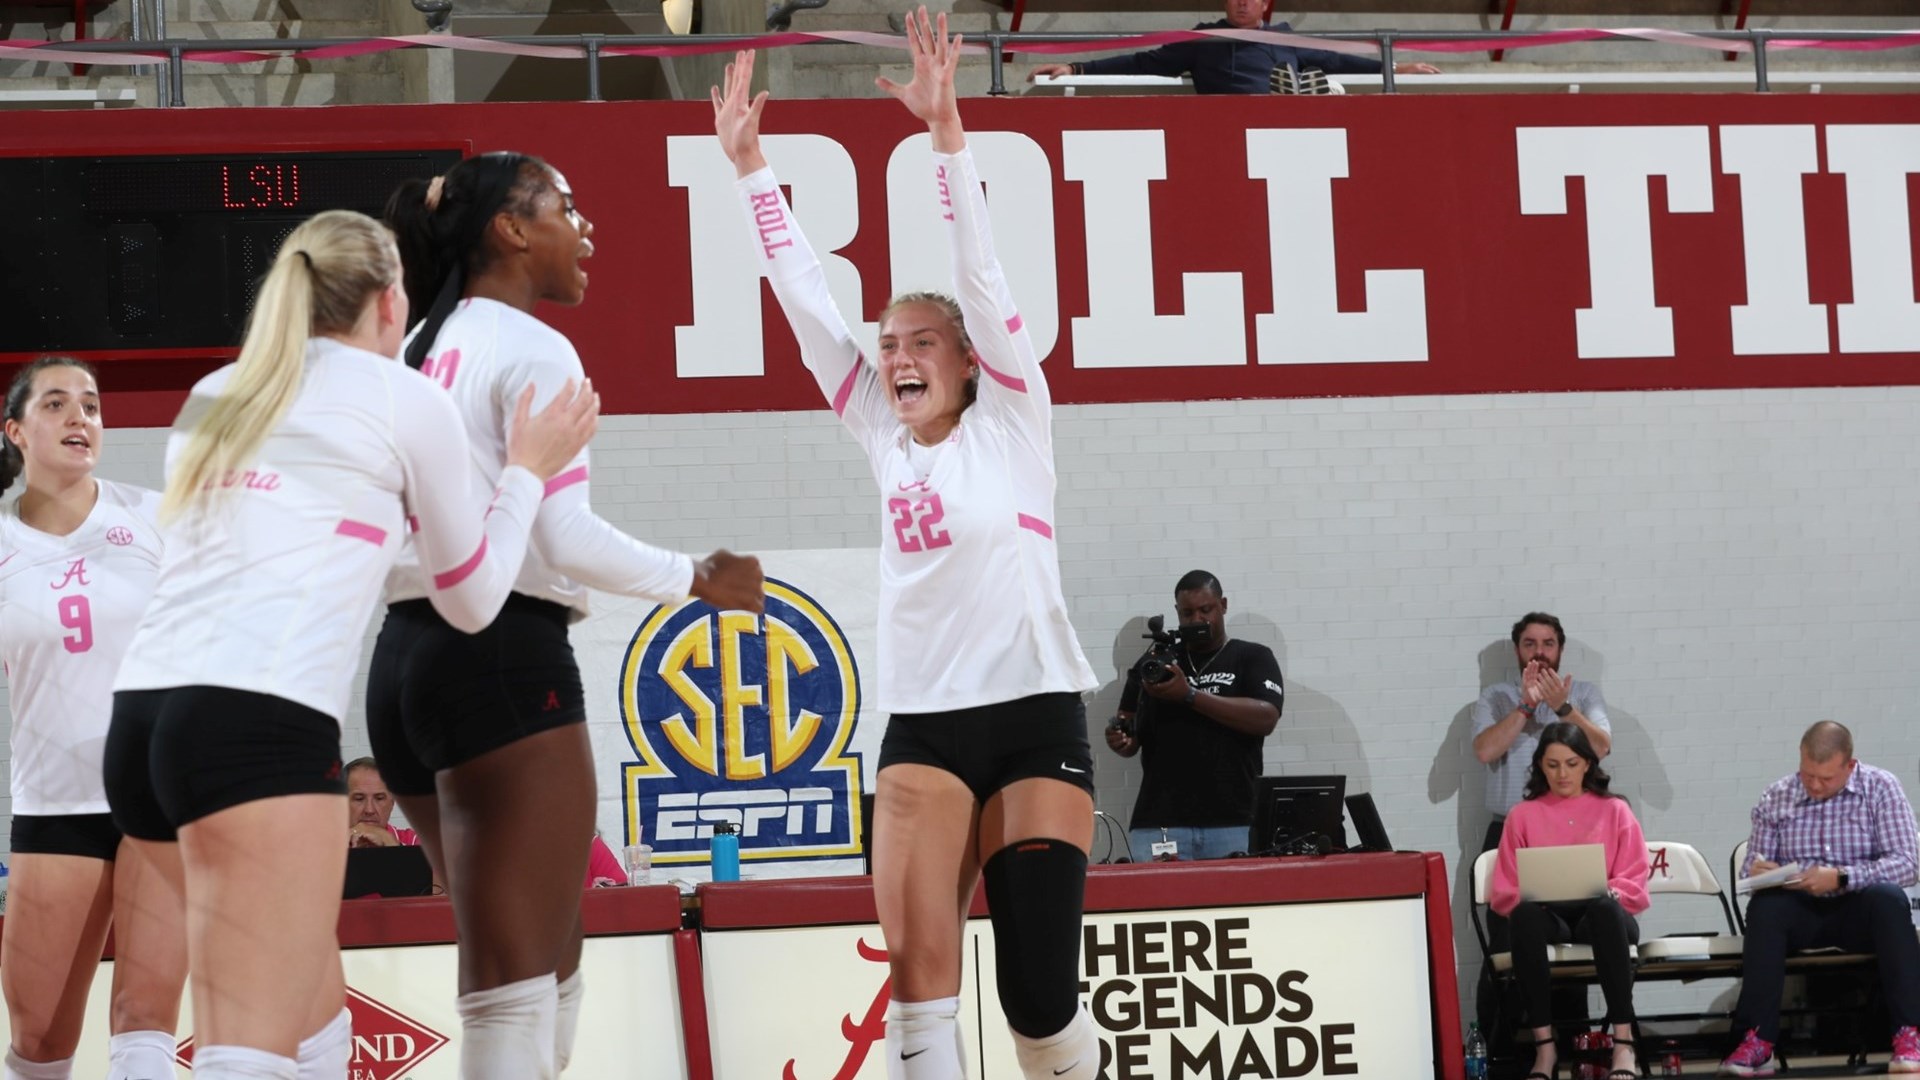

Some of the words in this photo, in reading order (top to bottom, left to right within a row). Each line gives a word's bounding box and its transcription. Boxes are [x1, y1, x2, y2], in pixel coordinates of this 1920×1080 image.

[223, 165, 299, 208] LSU
[667, 128, 1428, 377] ROLL
[750, 189, 793, 260] ROLL
[106, 526, 133, 546] SEC
[888, 493, 952, 553] 22
[51, 557, 91, 589] A
[58, 595, 93, 654] 9
[657, 610, 823, 781] SEC
[655, 787, 833, 840] ESPN
[1084, 917, 1253, 977] HERE
[1079, 970, 1314, 1032] GENDS
[1169, 1023, 1359, 1080] MADE
